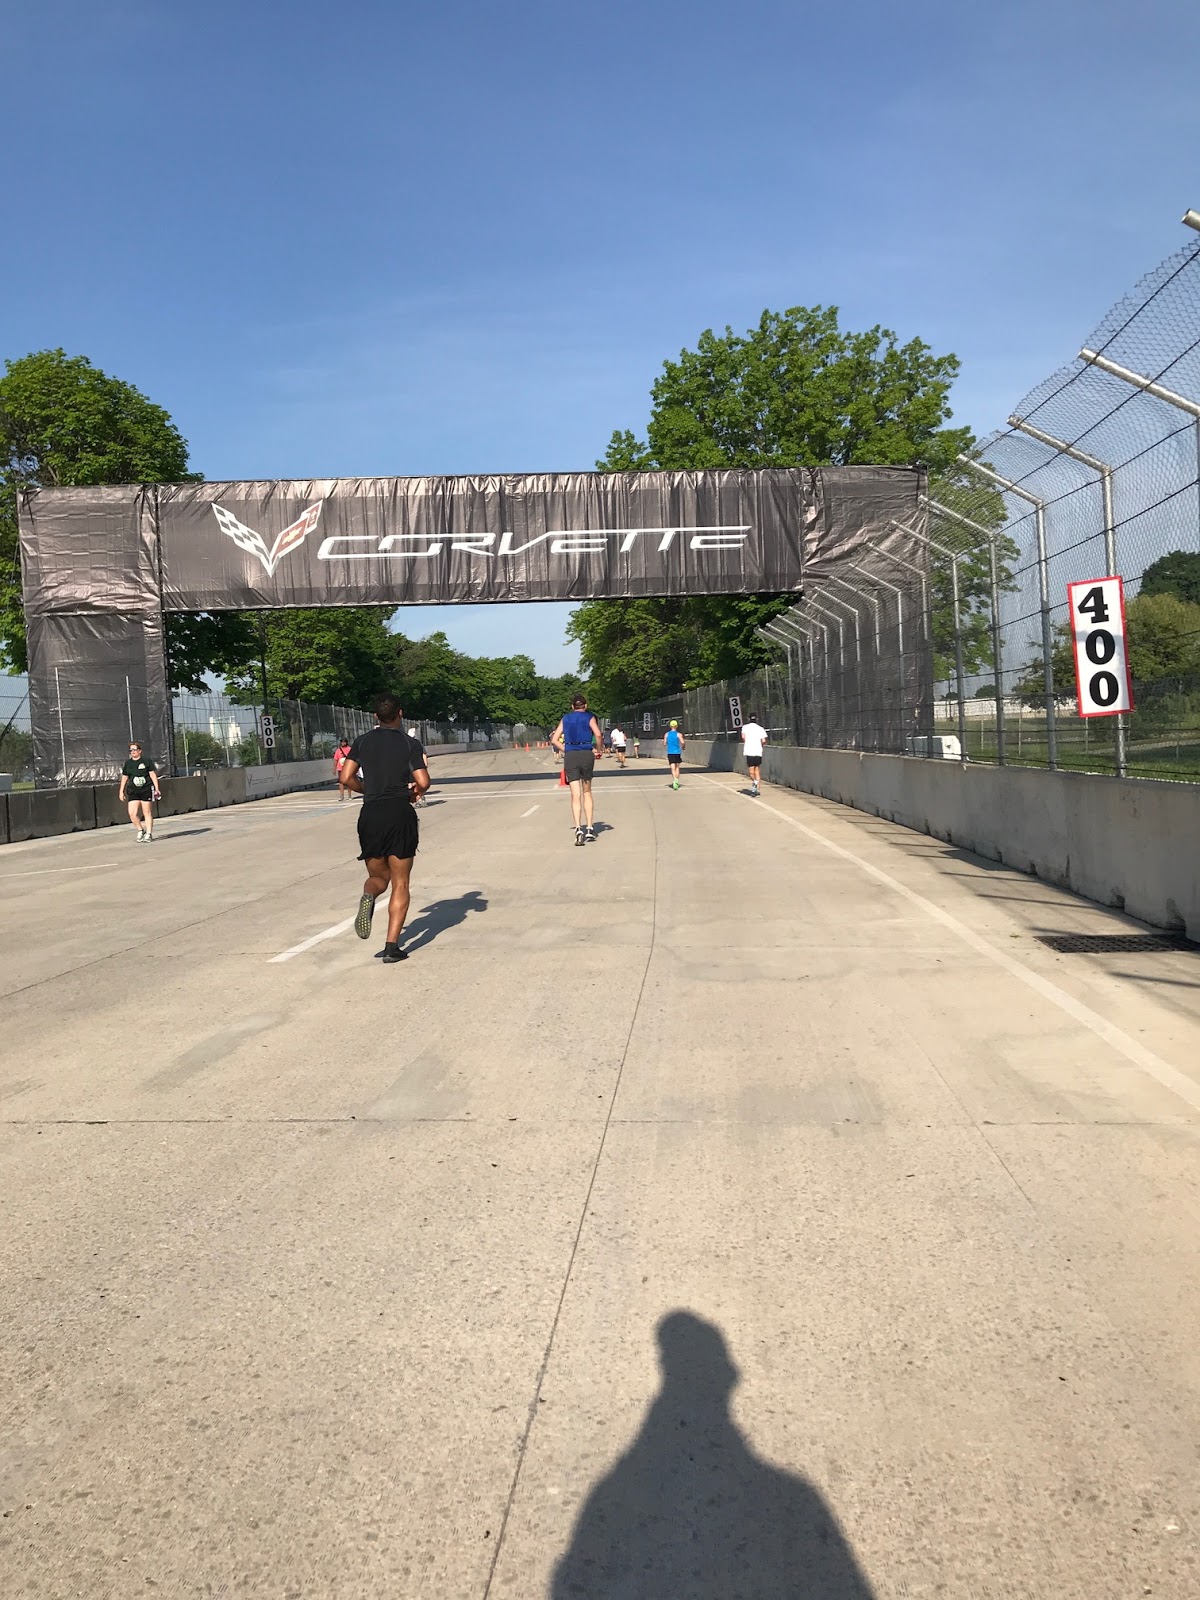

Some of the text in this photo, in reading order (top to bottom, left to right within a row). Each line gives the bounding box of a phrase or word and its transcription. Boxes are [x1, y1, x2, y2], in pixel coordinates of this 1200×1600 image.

[317, 526, 752, 560] CORVETTE
[1077, 586, 1119, 707] 400
[731, 698, 741, 727] 300
[263, 717, 273, 747] 300
